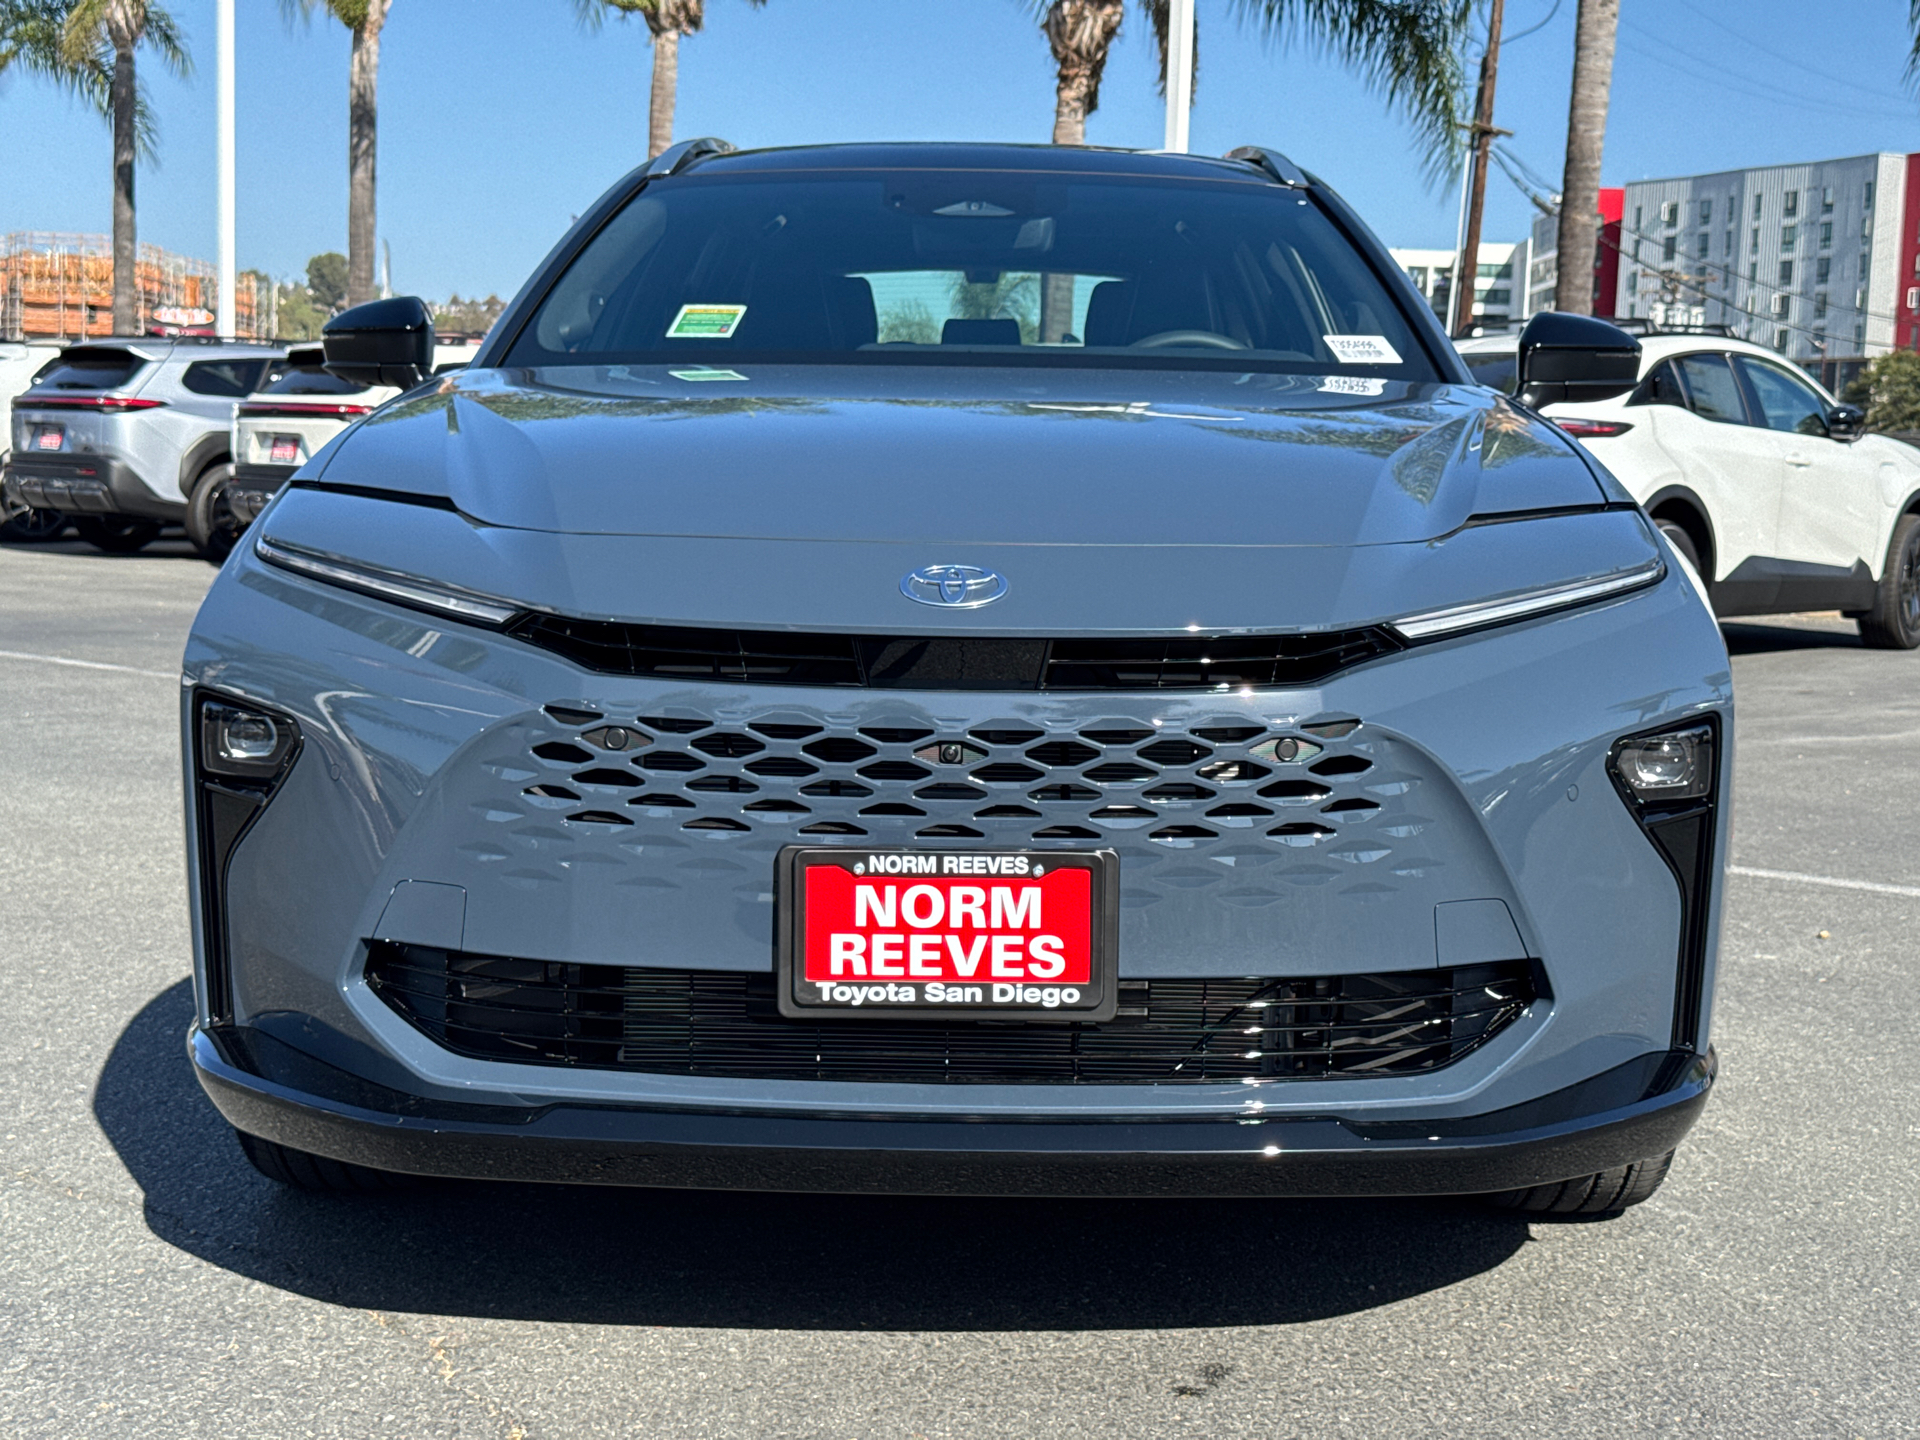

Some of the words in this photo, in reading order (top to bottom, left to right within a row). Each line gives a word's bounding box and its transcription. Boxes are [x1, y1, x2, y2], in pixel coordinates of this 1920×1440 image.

[870, 855, 936, 873] NORM
[943, 856, 1029, 874] REEVES
[856, 885, 1041, 928] NORM
[831, 934, 1065, 978] REEVES
[816, 982, 915, 1005] Toyota
[925, 982, 982, 1002] San
[993, 983, 1080, 1007] Diego
